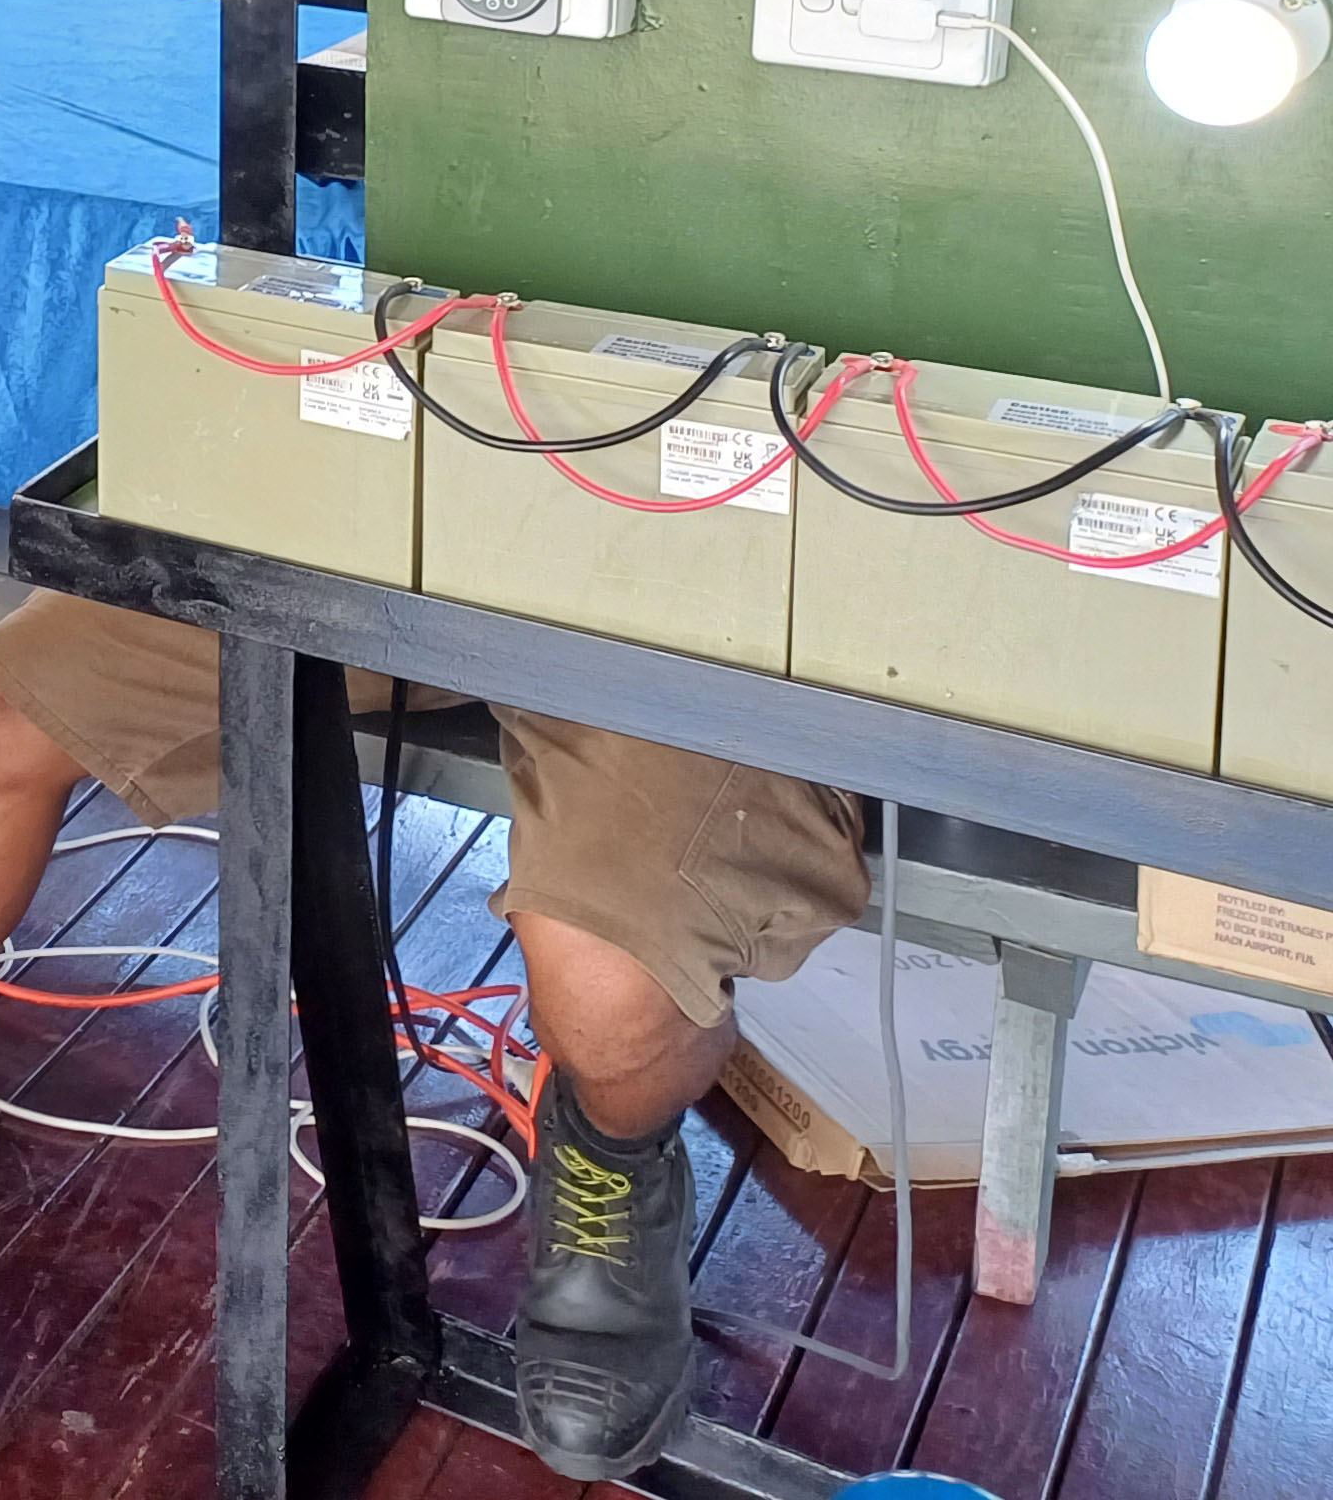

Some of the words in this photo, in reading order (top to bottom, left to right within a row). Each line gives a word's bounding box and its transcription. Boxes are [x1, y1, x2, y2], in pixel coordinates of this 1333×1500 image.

[1216, 892, 1267, 912] BOTTLED
[1215, 918, 1232, 931] PO
[1233, 922, 1257, 938] BOX
[1260, 916, 1324, 940] BEVERAGES
[1071, 1030, 1221, 1057] victron
